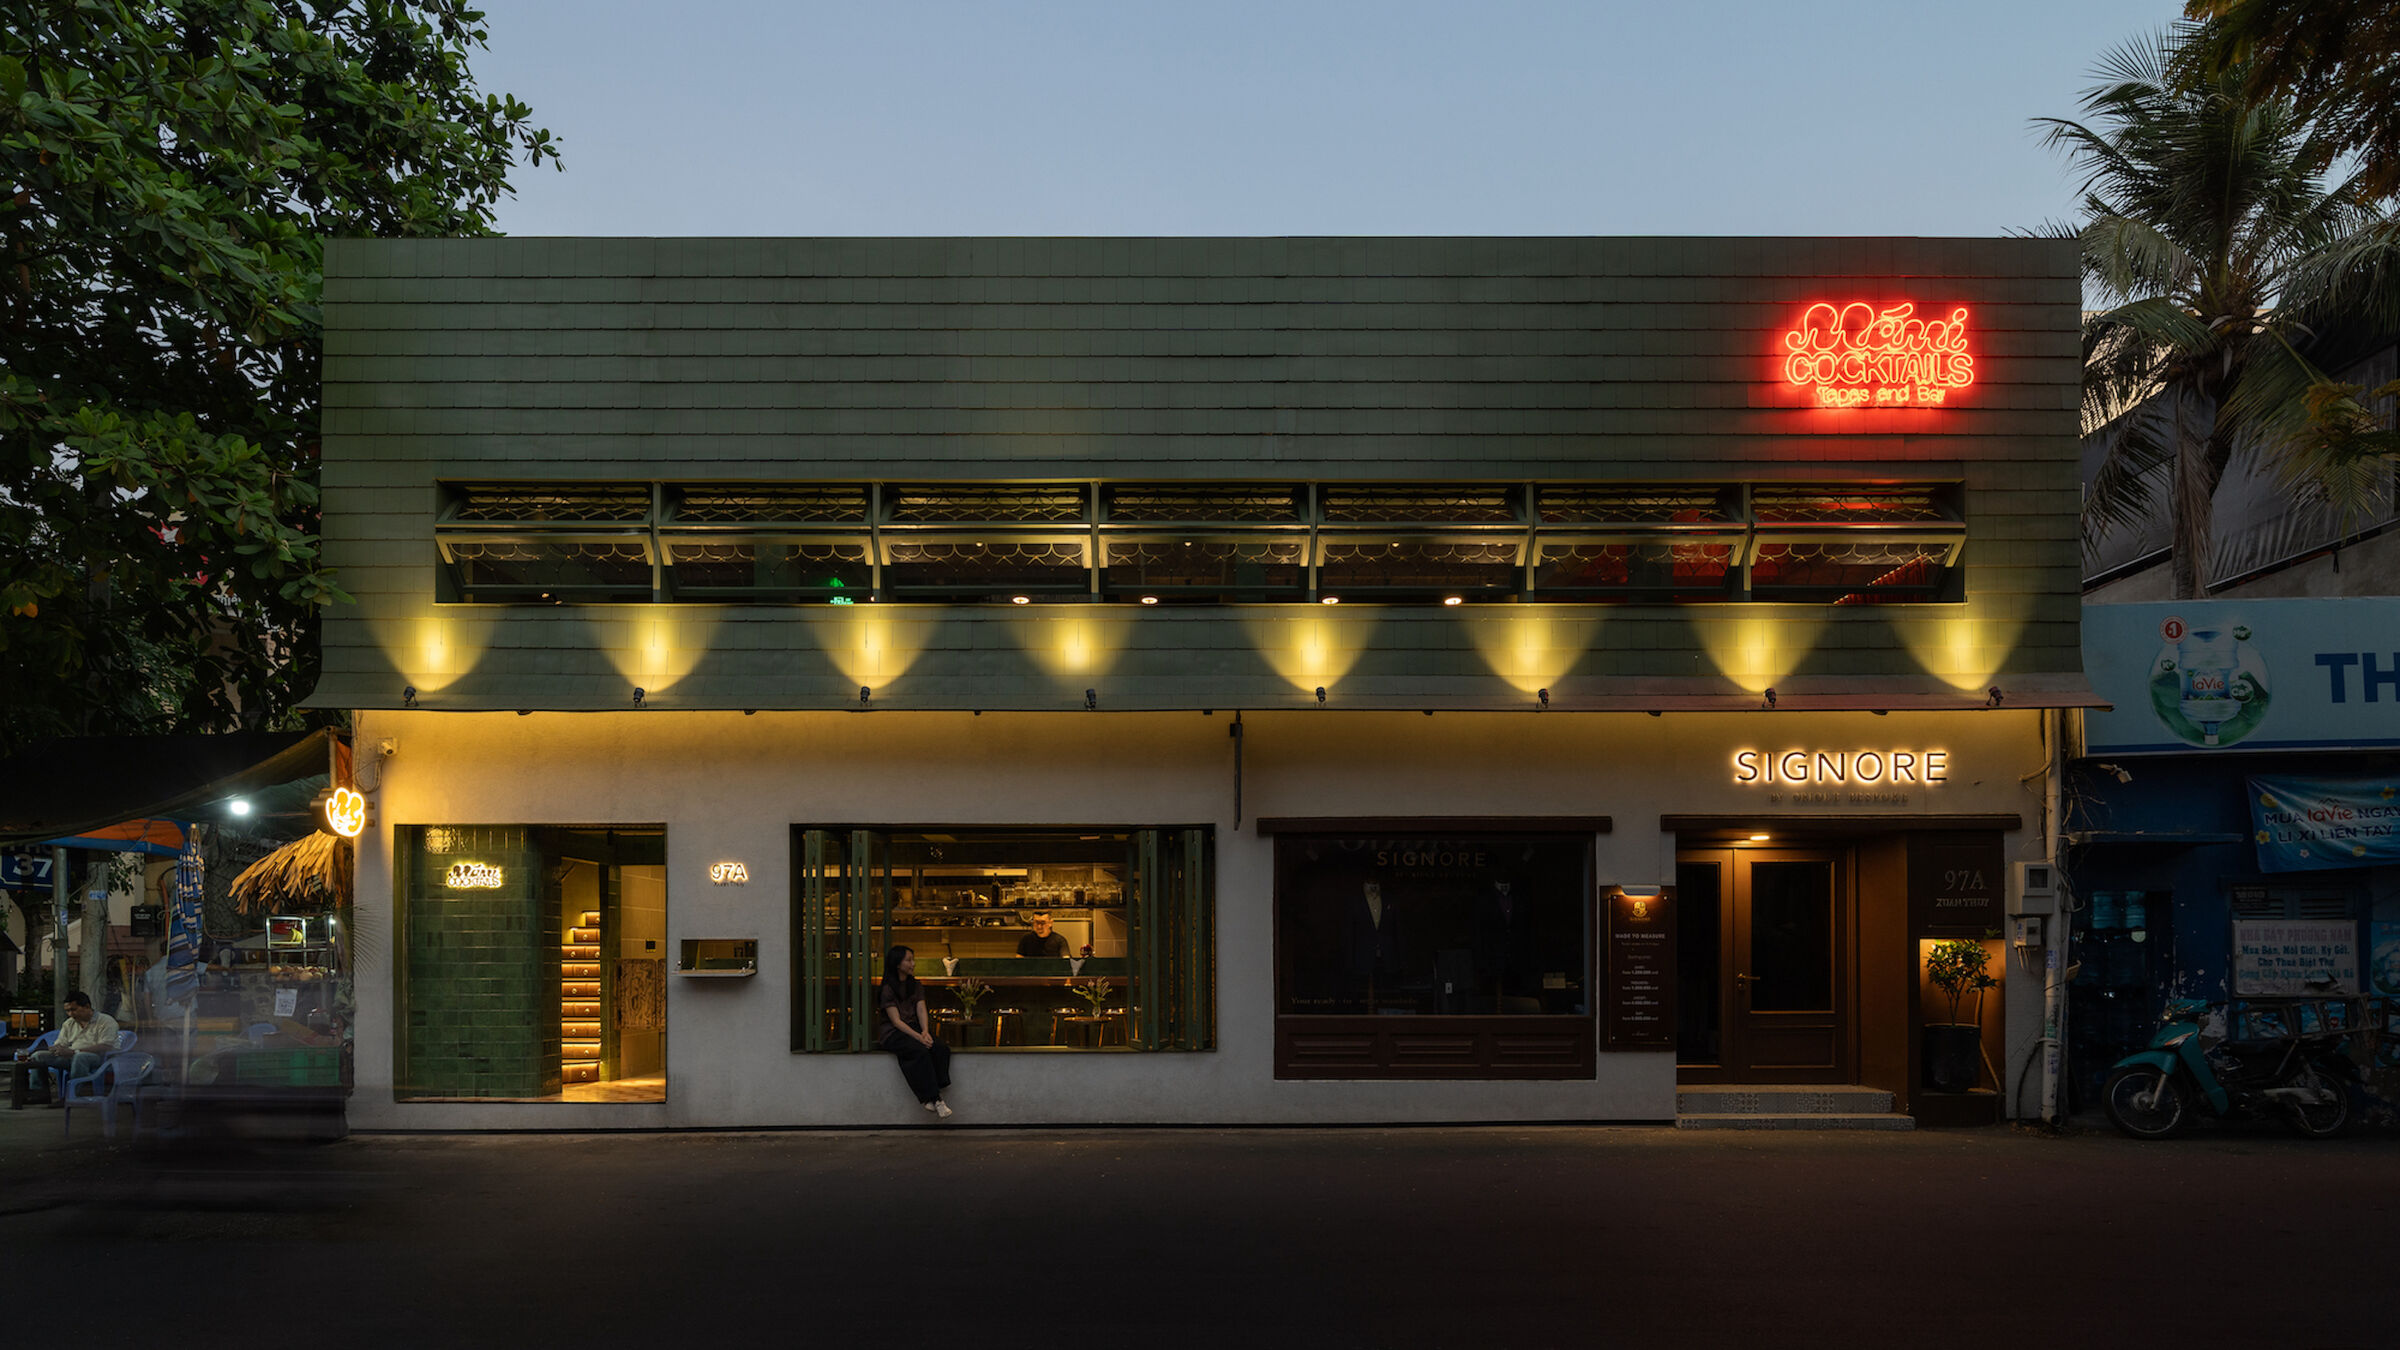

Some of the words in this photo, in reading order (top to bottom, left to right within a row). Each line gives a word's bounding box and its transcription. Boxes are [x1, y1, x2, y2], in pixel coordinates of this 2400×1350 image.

[1786, 351, 1974, 387] COCKTAILS
[1816, 386, 1868, 407] Tapas
[1876, 385, 1909, 402] and
[1917, 386, 1945, 403] Bar
[2314, 652, 2400, 703] TH
[1736, 751, 1948, 782] SIGNORE
[2264, 812, 2305, 824] MUA
[2307, 805, 2353, 822] laVie
[2361, 825, 2392, 837] TAY
[12, 853, 54, 878] 37
[1375, 850, 1487, 867] SIGNORE
[711, 863, 746, 880] 97A
[1944, 869, 1986, 892] 97A
